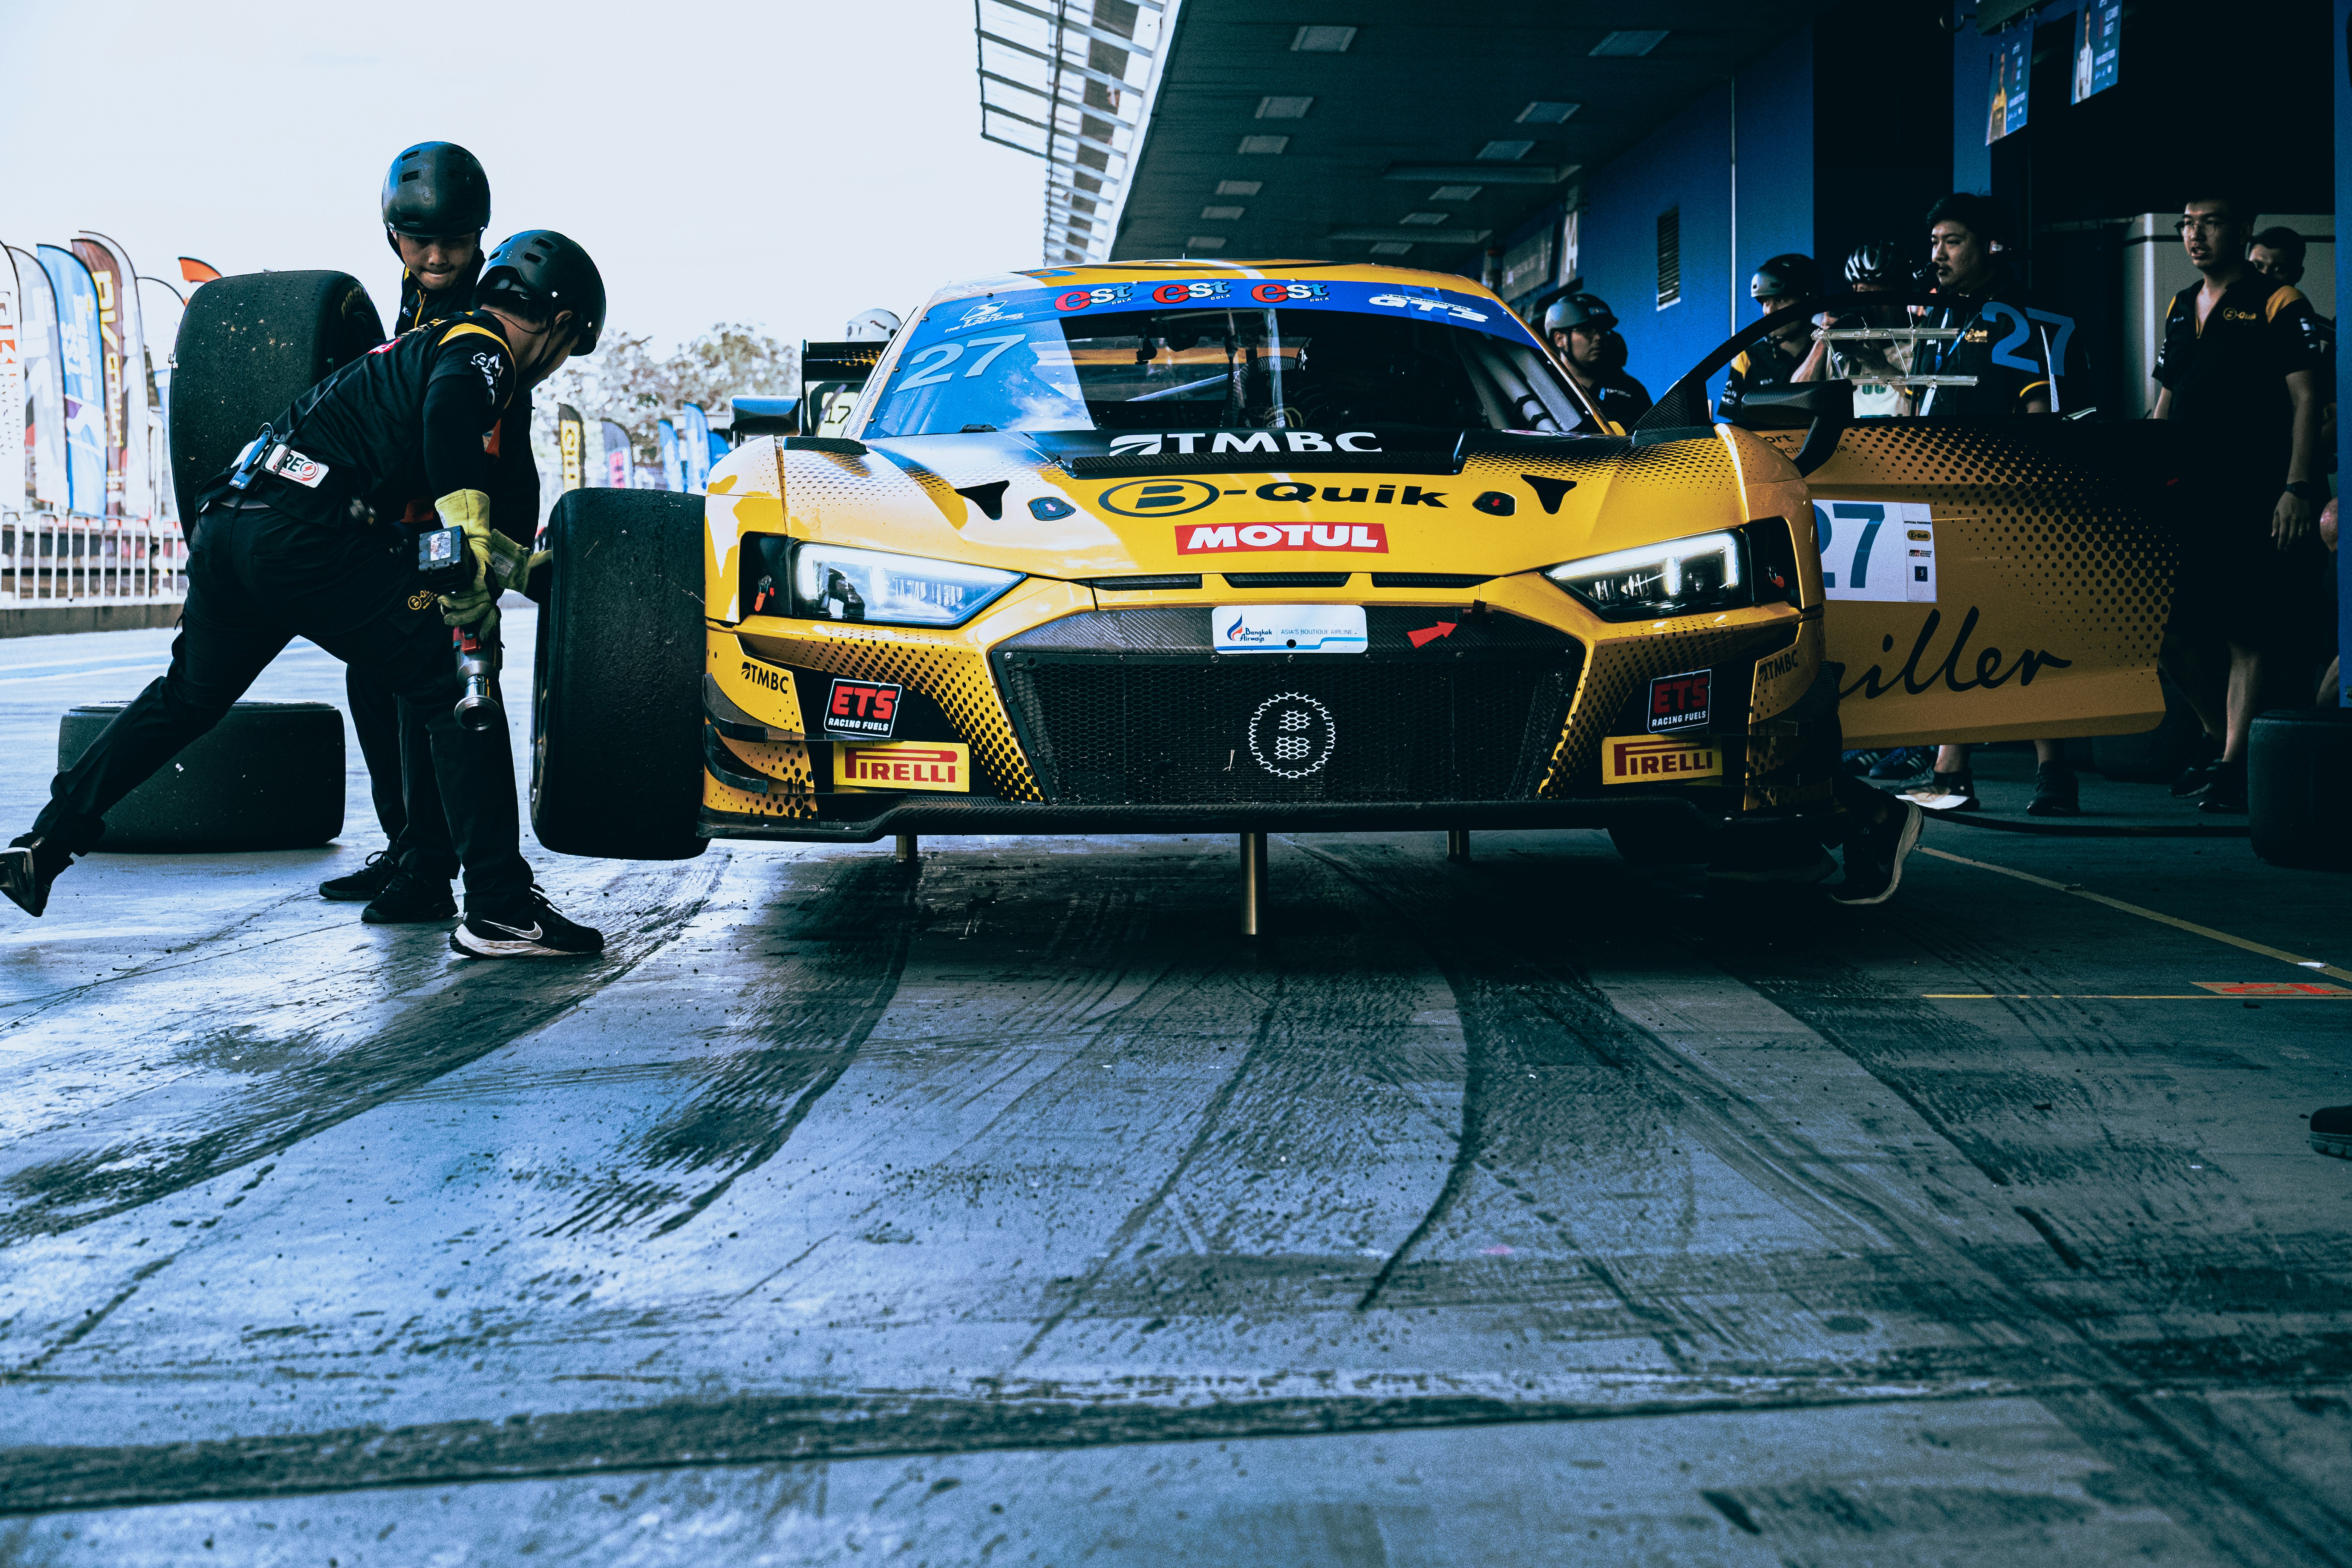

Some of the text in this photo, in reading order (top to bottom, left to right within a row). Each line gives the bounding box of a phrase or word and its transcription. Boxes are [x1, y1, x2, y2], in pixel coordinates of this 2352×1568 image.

[1054, 285, 1133, 311] est
[1153, 281, 1232, 304] est
[1251, 283, 1329, 303] est
[962, 318, 992, 328] SUPER
[992, 312, 1024, 322] SERIES
[964, 312, 1004, 325] TSS
[1369, 296, 1488, 322] GT3
[1981, 302, 2075, 377] 27
[895, 334, 1026, 392] 27
[1167, 432, 1382, 454] TMBC
[1764, 434, 1795, 443] ort
[1098, 478, 1449, 518] B-Quik
[1187, 524, 1378, 550] MOTUL
[1240, 634, 1265, 643] Airways
[1245, 626, 1272, 637] Bangkok
[1767, 649, 1799, 680] TMBC
[1833, 605, 2072, 700] iller
[751, 664, 789, 694] TMBC
[832, 686, 897, 720] ETS
[1654, 677, 1707, 714] ETS
[828, 718, 889, 732] RACING FUELS
[1652, 710, 1706, 727] RACING FUELS
[845, 747, 957, 783] PIRELLI
[1614, 738, 1713, 776] PIRELLI
